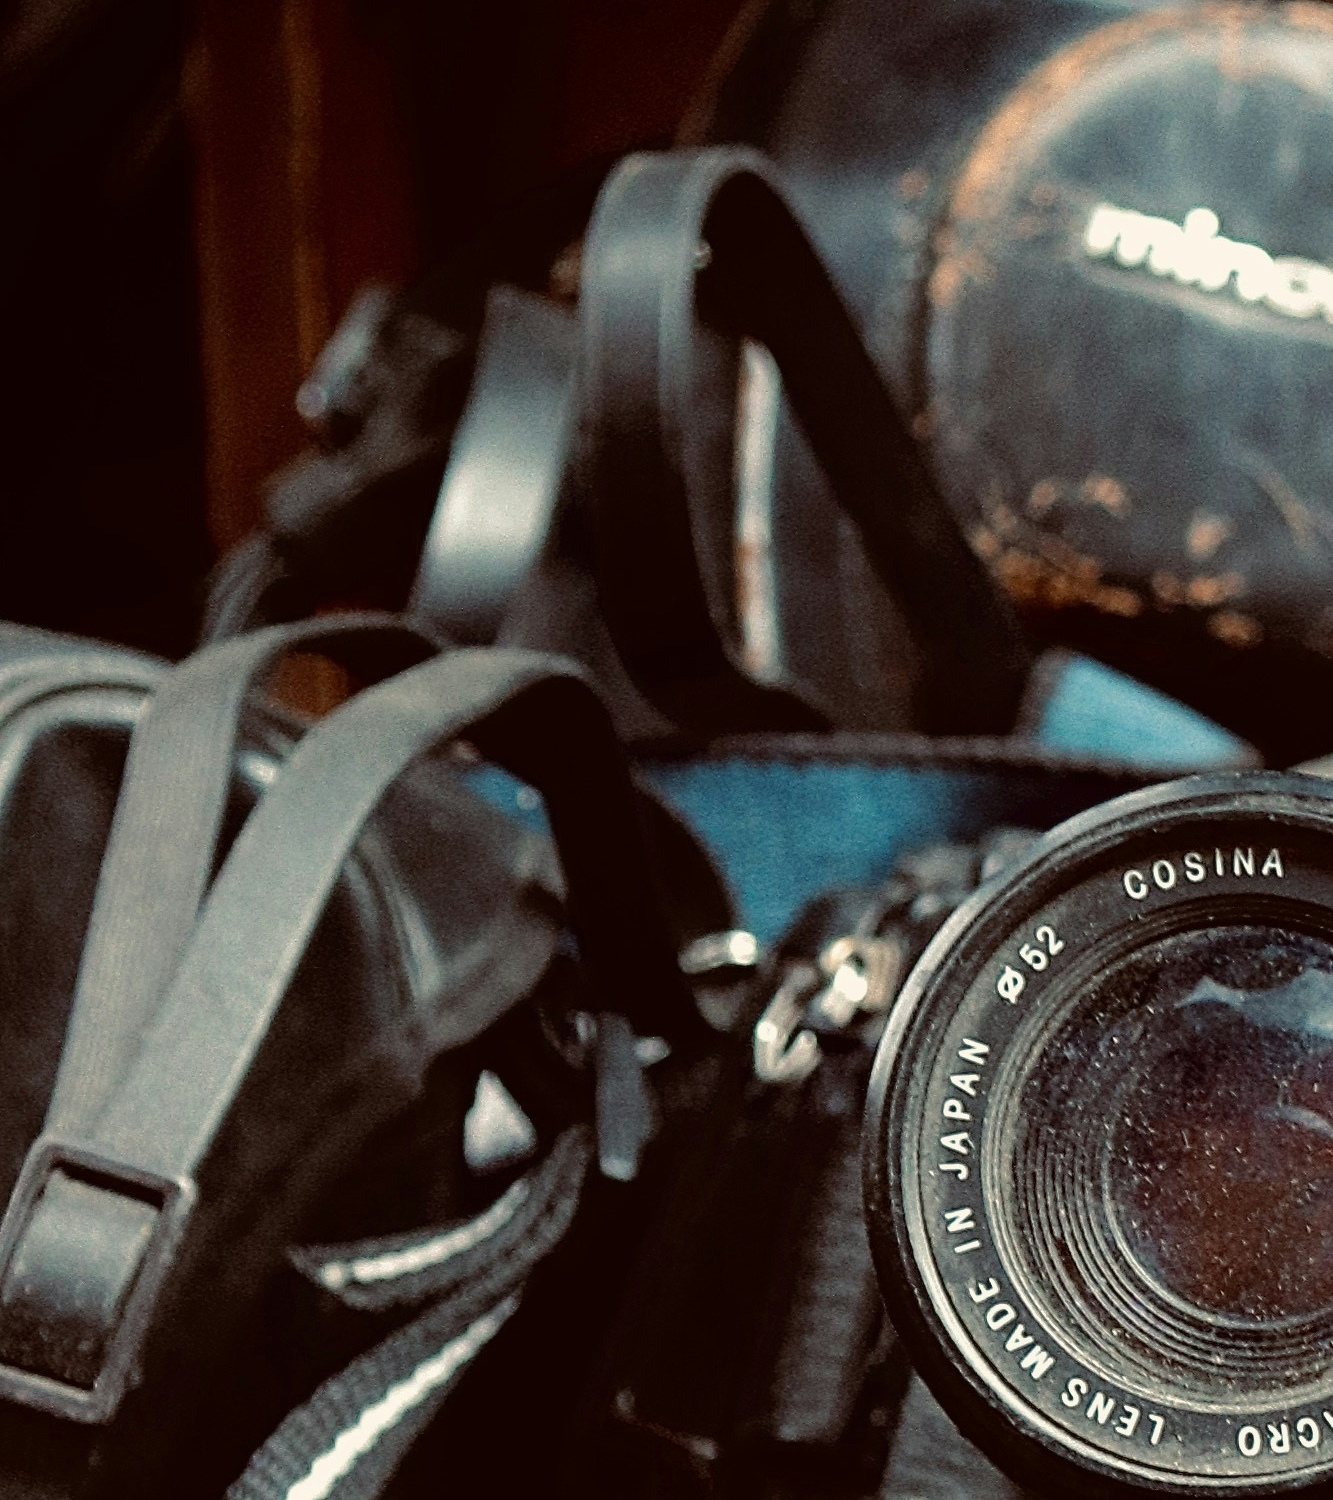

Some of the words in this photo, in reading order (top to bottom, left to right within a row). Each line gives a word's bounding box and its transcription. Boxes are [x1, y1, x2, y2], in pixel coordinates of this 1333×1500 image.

[1123, 847, 1286, 900] COSINA
[941, 1038, 990, 1181] JAPAN
[945, 1206, 982, 1255] IN
[967, 1275, 1055, 1381] MADE
[1061, 1377, 1164, 1446] LENS
